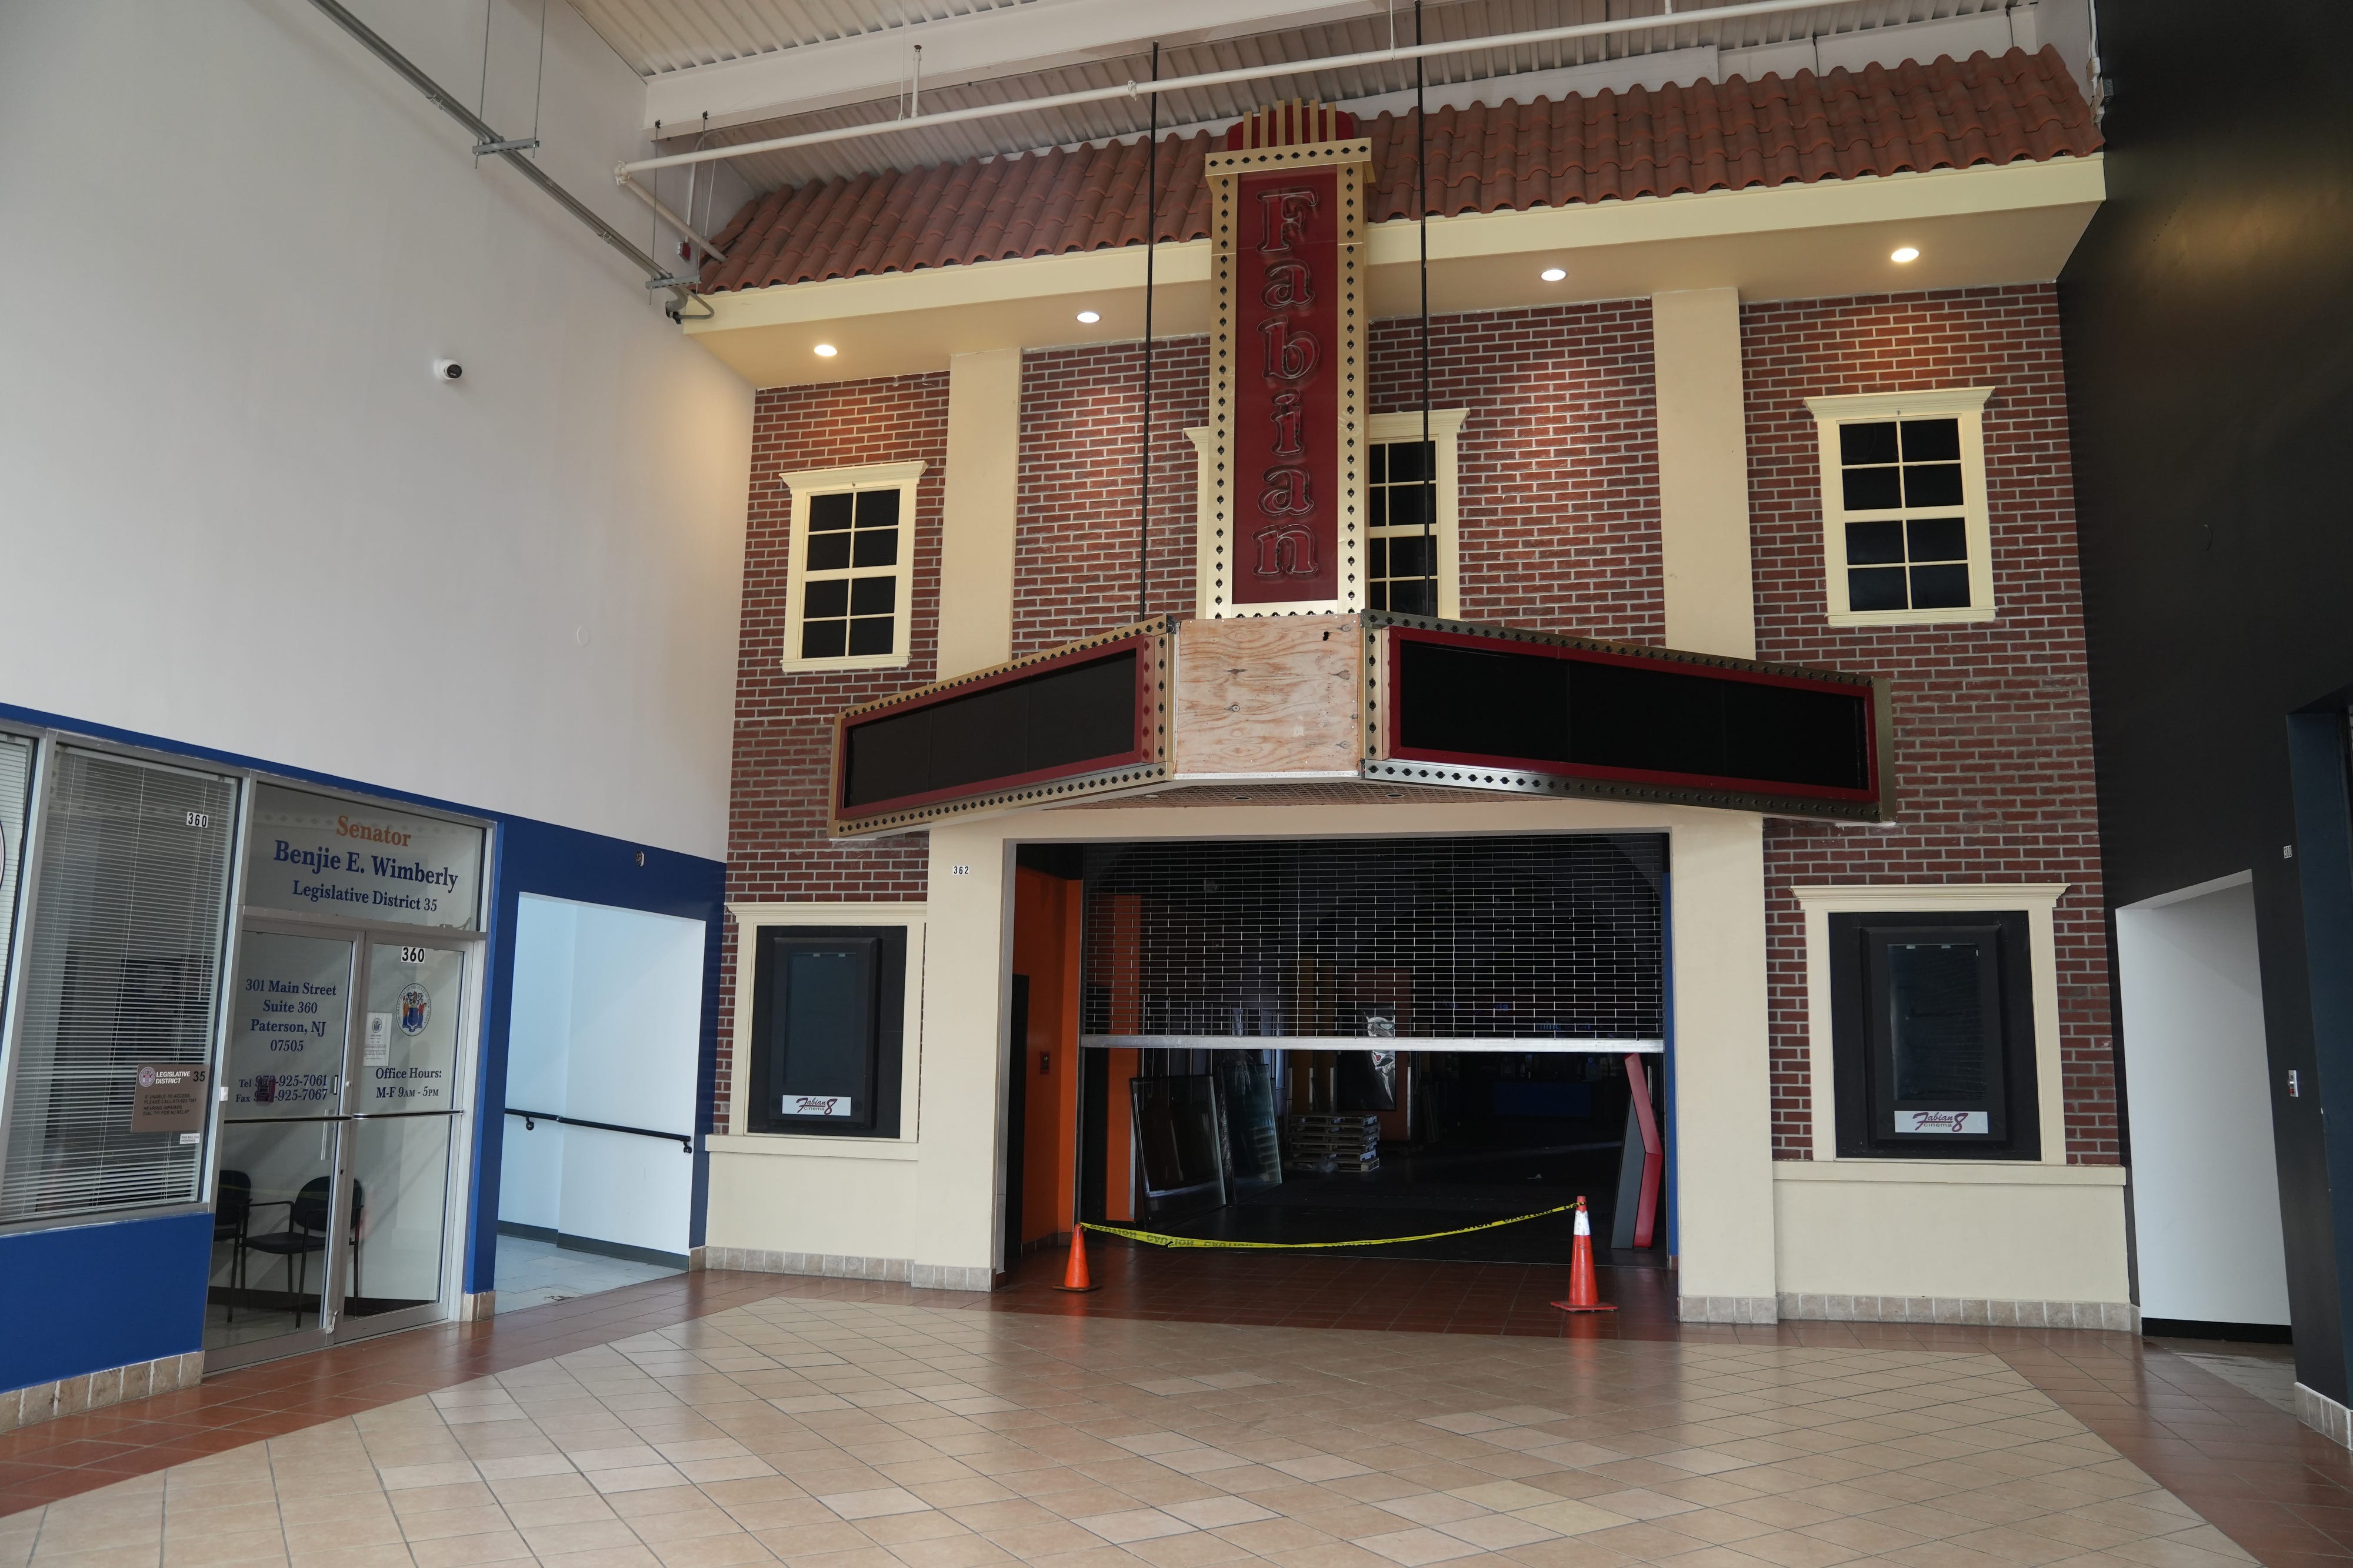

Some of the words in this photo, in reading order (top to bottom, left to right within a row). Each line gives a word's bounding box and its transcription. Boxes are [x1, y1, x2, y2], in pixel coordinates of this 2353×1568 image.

[1252, 185, 1320, 581] Fabian
[188, 813, 207, 827] 360
[336, 815, 411, 847] Senator
[273, 839, 341, 875] Benjie
[346, 851, 365, 873] E.
[371, 855, 458, 893] Wimberly
[954, 866, 969, 875] 362
[292, 880, 369, 902] Legislative
[372, 890, 421, 911] District
[424, 898, 438, 912] 35
[402, 947, 425, 962] 360
[245, 979, 265, 992] 301
[268, 980, 299, 993] Main
[302, 982, 337, 996] Street
[263, 1000, 294, 1013] Suite
[298, 1002, 318, 1014] 360
[250, 1019, 308, 1035] Paterson,
[311, 1021, 326, 1037] NJ
[270, 1039, 304, 1052] 07505
[193, 1071, 205, 1082] 35
[375, 1067, 406, 1079] Office
[409, 1067, 442, 1079] Hours:
[239, 1079, 252, 1087] Tel
[235, 1094, 251, 1103] Fax
[376, 1087, 396, 1098] M-F
[398, 1086, 415, 1097] 9AM
[422, 1086, 439, 1096] 5PM
[796, 1097, 826, 1113] Fabian
[824, 1098, 838, 1115] 8
[1912, 1112, 1954, 1130] Fabian
[1951, 1113, 1969, 1132] 8
